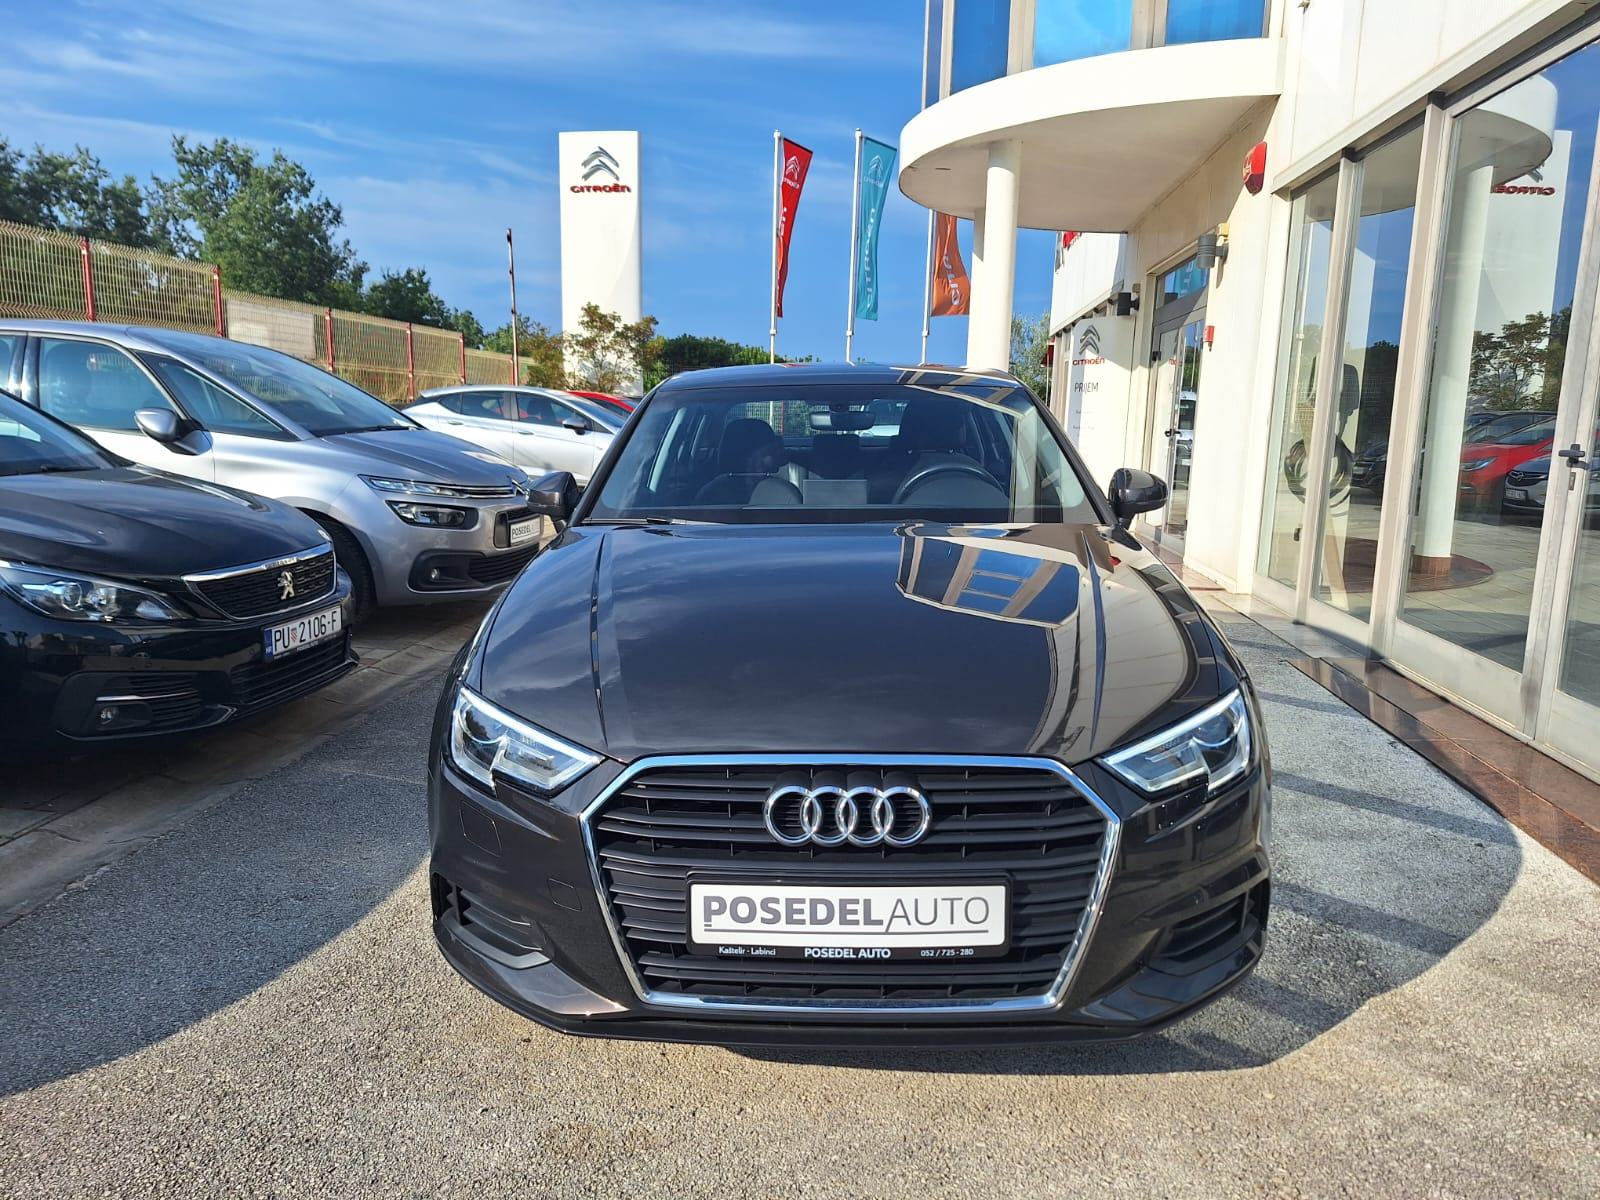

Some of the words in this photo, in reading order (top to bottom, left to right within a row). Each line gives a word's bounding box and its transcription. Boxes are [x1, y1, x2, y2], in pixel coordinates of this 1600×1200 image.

[570, 183, 631, 193] CITROËN
[274, 626, 290, 653] PU
[751, 947, 776, 956] Labinci
[804, 948, 856, 958] POSEDEL
[858, 948, 892, 958] AUTO
[960, 948, 974, 956] 280
